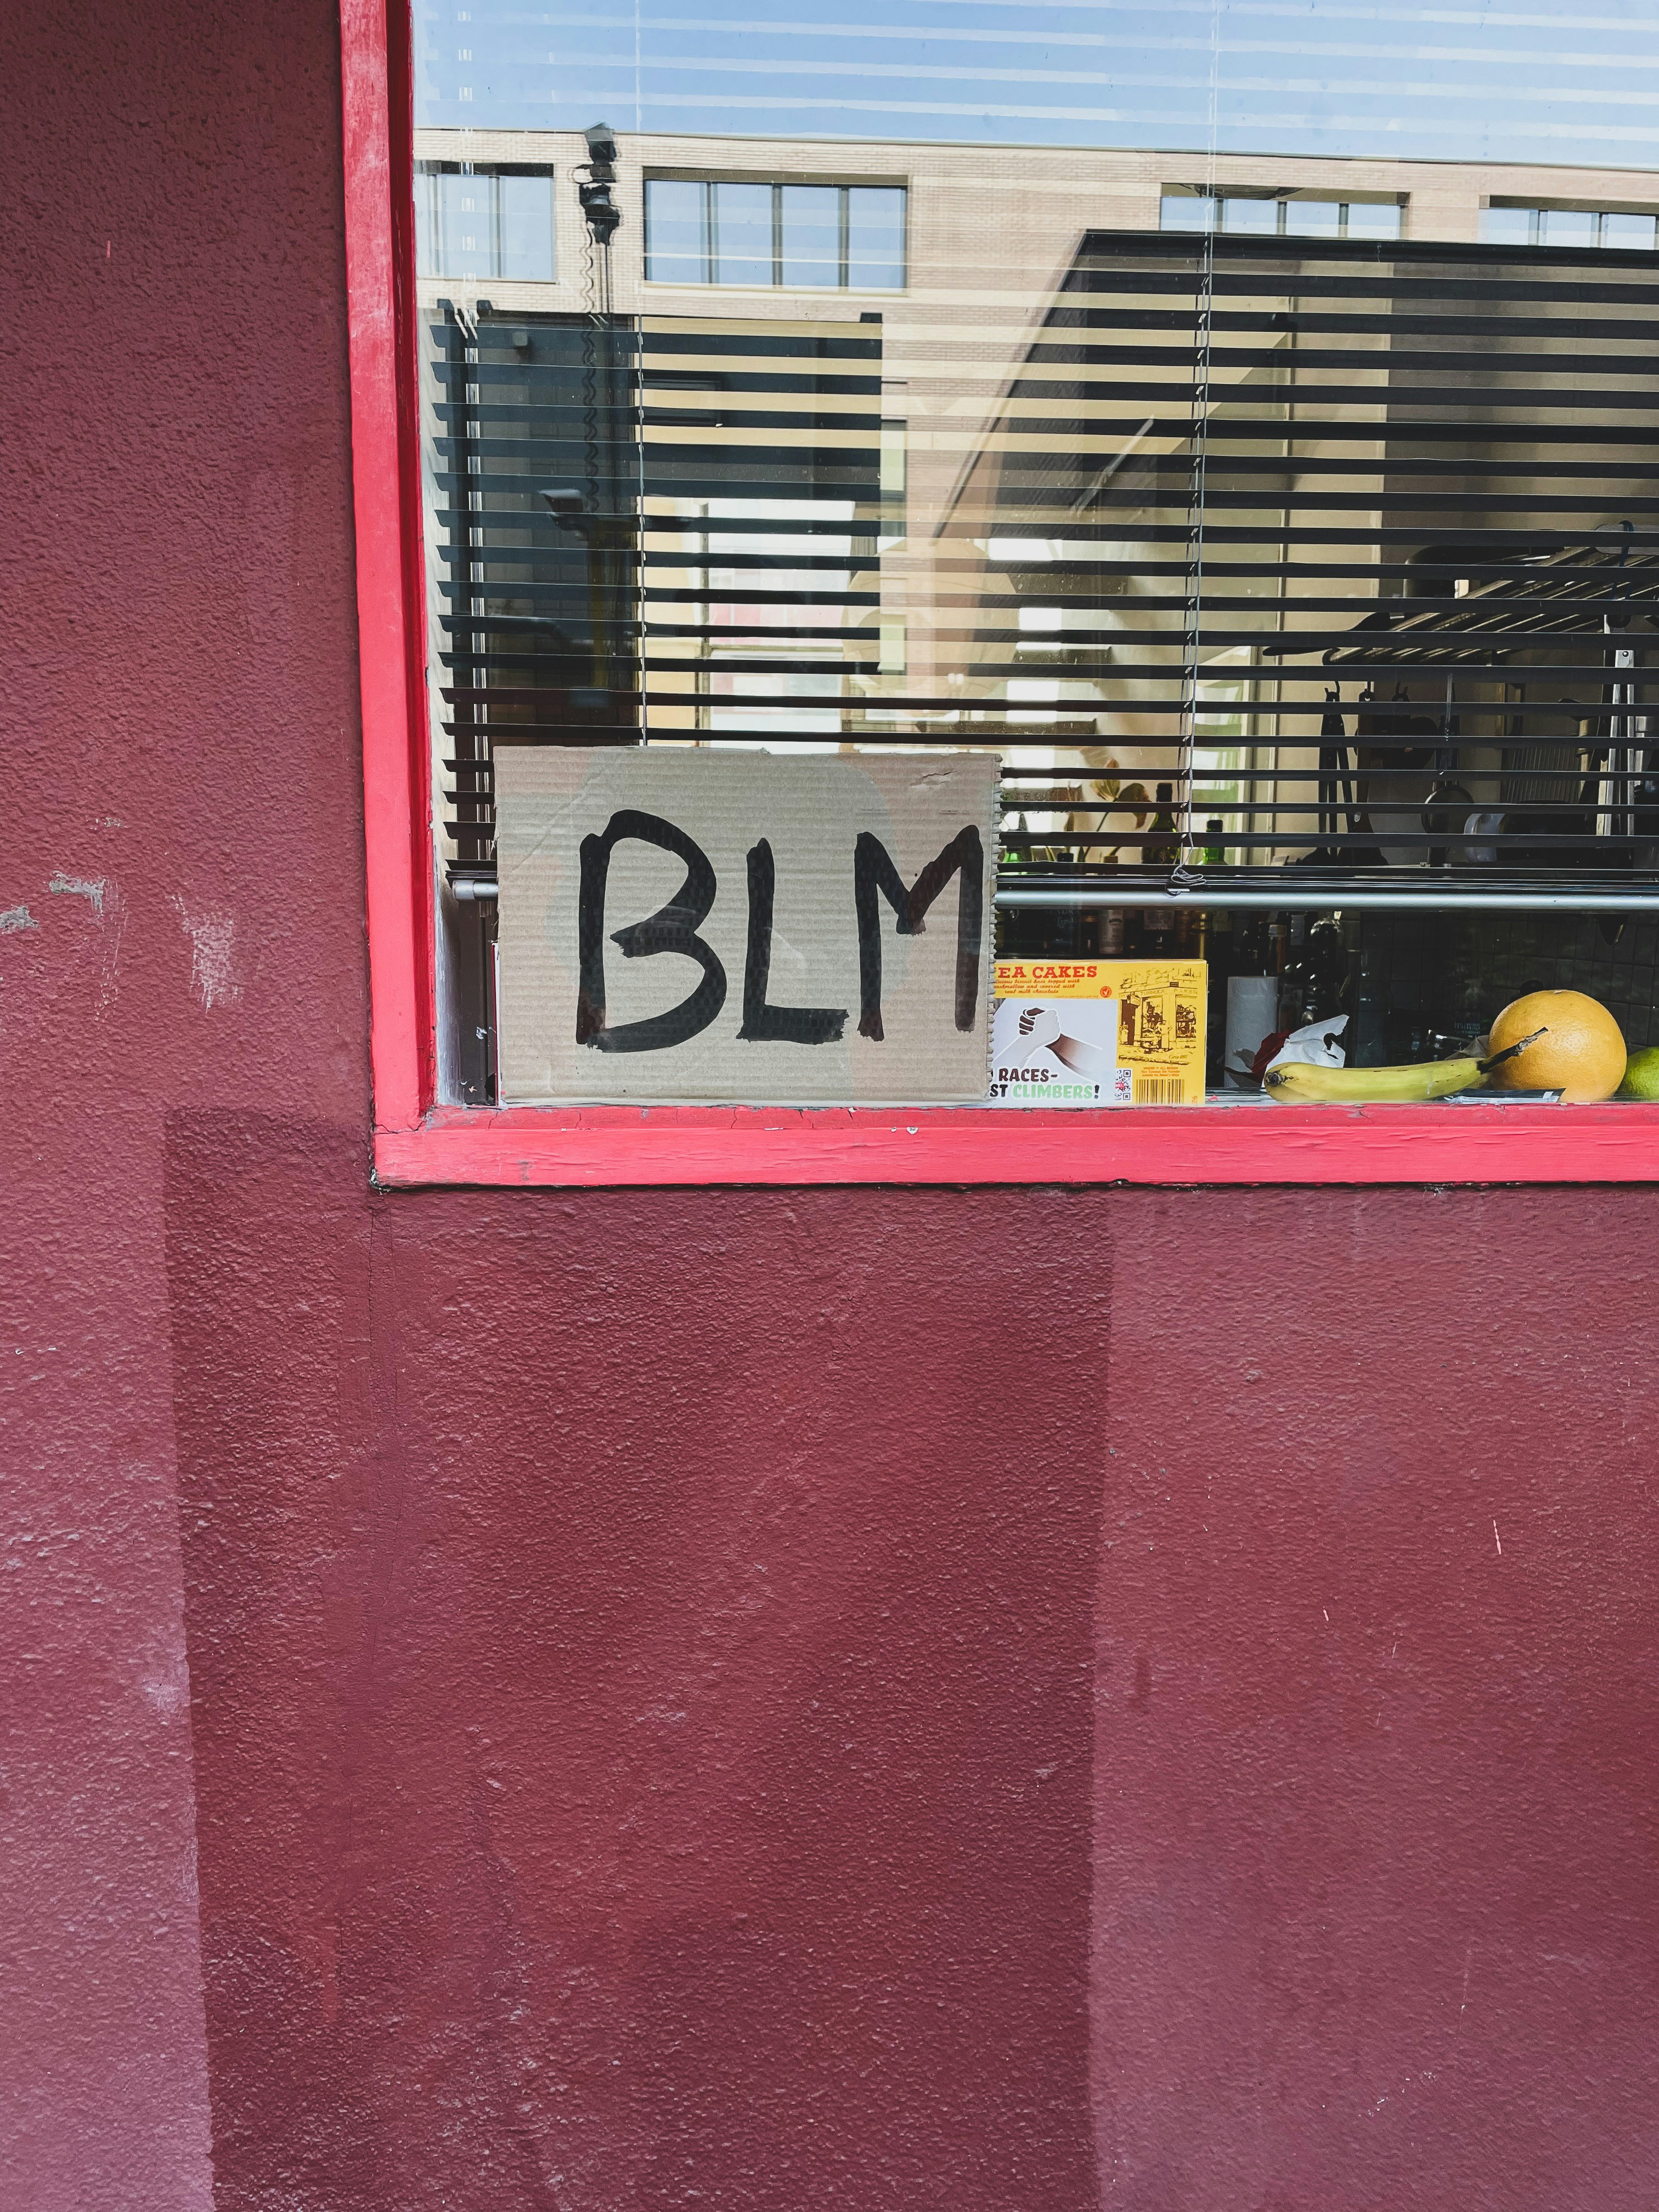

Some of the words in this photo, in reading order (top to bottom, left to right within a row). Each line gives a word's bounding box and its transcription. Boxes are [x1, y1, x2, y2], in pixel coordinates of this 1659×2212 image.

[576, 810, 984, 1053] BLM
[995, 967, 1026, 978] EA
[1032, 966, 1097, 979] CAKES
[998, 1068, 1058, 1082] RACES-
[1013, 1084, 1100, 1099] CLIMBERS!
